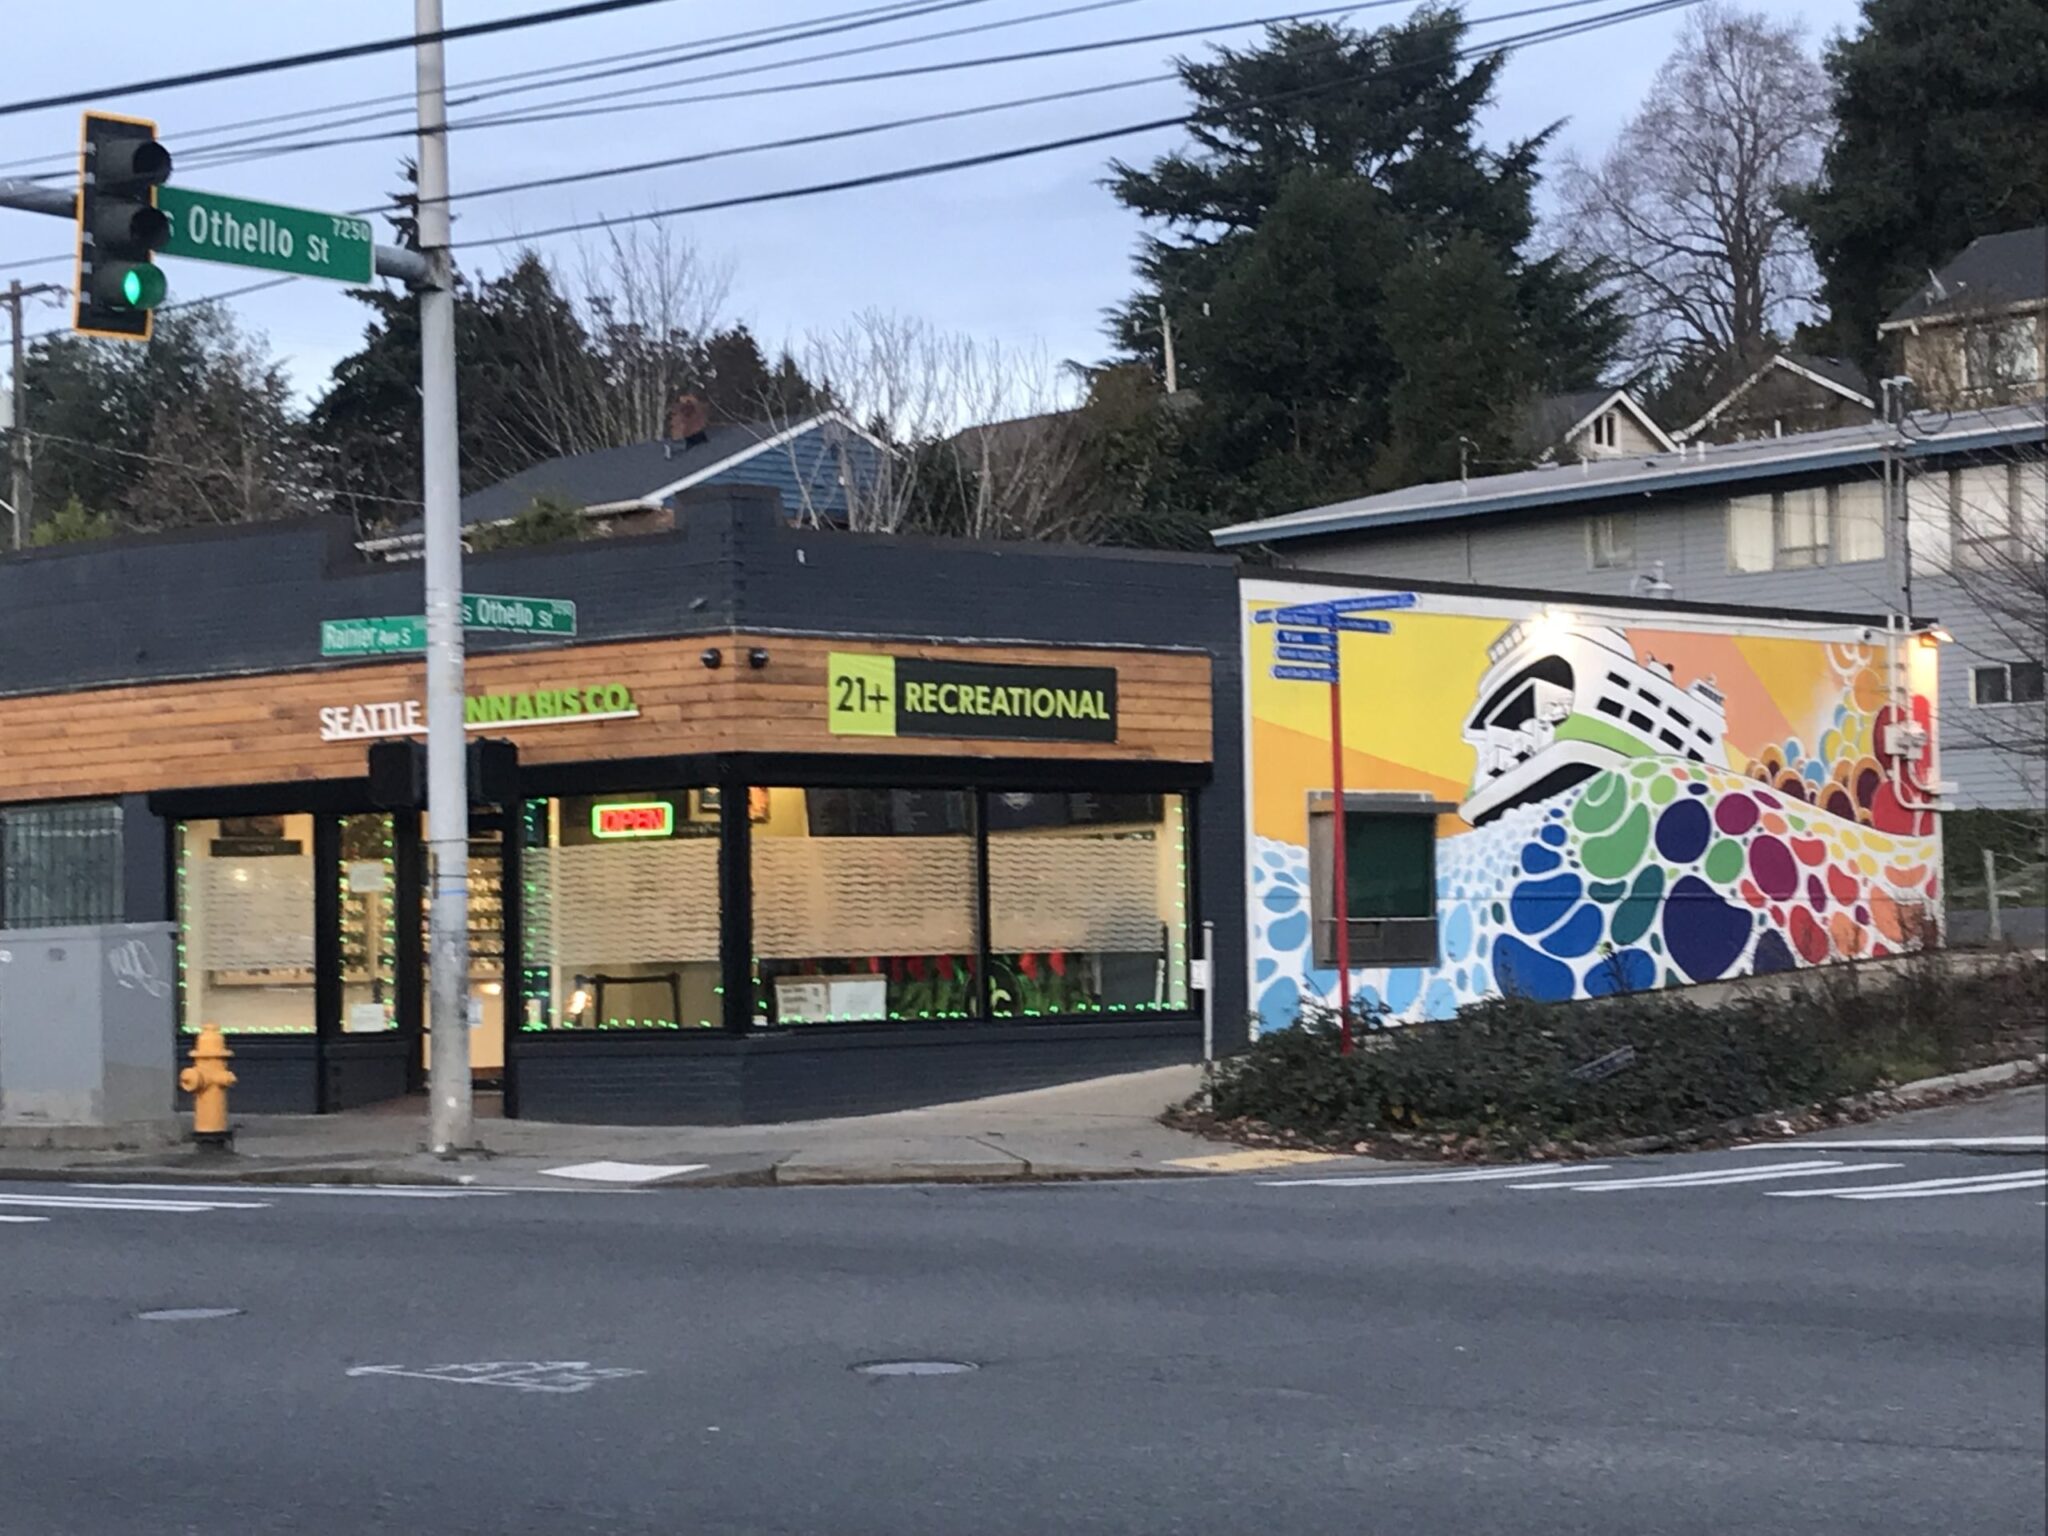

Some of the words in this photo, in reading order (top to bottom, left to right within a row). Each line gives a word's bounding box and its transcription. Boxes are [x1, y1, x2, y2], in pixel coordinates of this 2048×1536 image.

[188, 204, 294, 259] Othello
[306, 234, 330, 265] St
[331, 216, 369, 242] 7250
[477, 598, 534, 627] Othello
[537, 609, 554, 628] St
[319, 700, 421, 737] SEATTLE
[464, 686, 581, 724] NNABIS
[584, 682, 637, 714] CO.
[835, 675, 889, 713] 21+
[905, 681, 1111, 720] RECREATIONAL
[602, 808, 665, 832] OPEN
